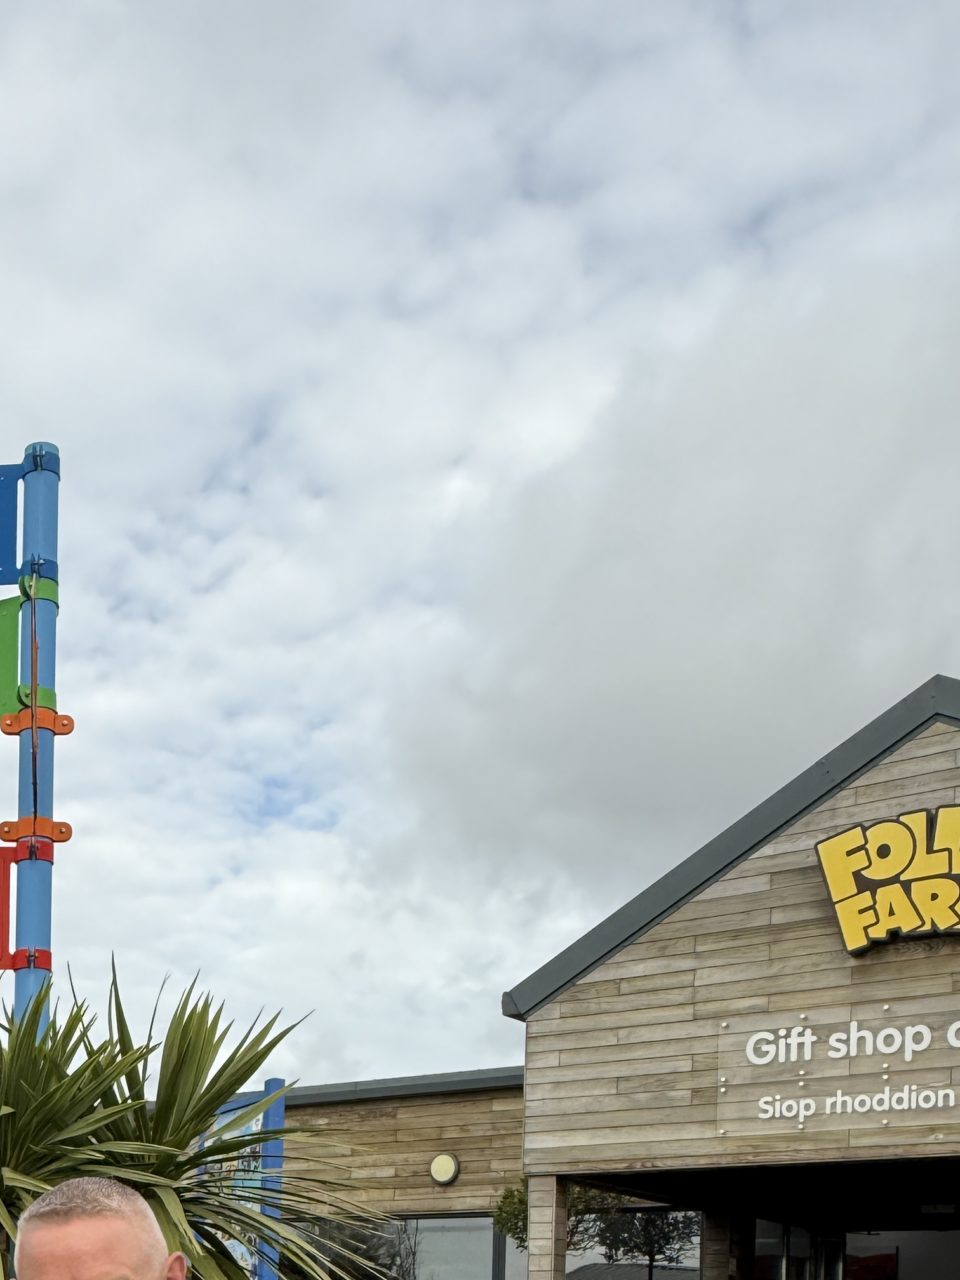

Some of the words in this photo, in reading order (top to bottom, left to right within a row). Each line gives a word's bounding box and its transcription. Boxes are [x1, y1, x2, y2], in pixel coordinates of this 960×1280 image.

[834, 877, 960, 951] FAR
[745, 1026, 818, 1065] Gift
[827, 1020, 932, 1062] shop
[757, 1094, 816, 1122] Siop
[825, 1084, 956, 1114] rhoddion
